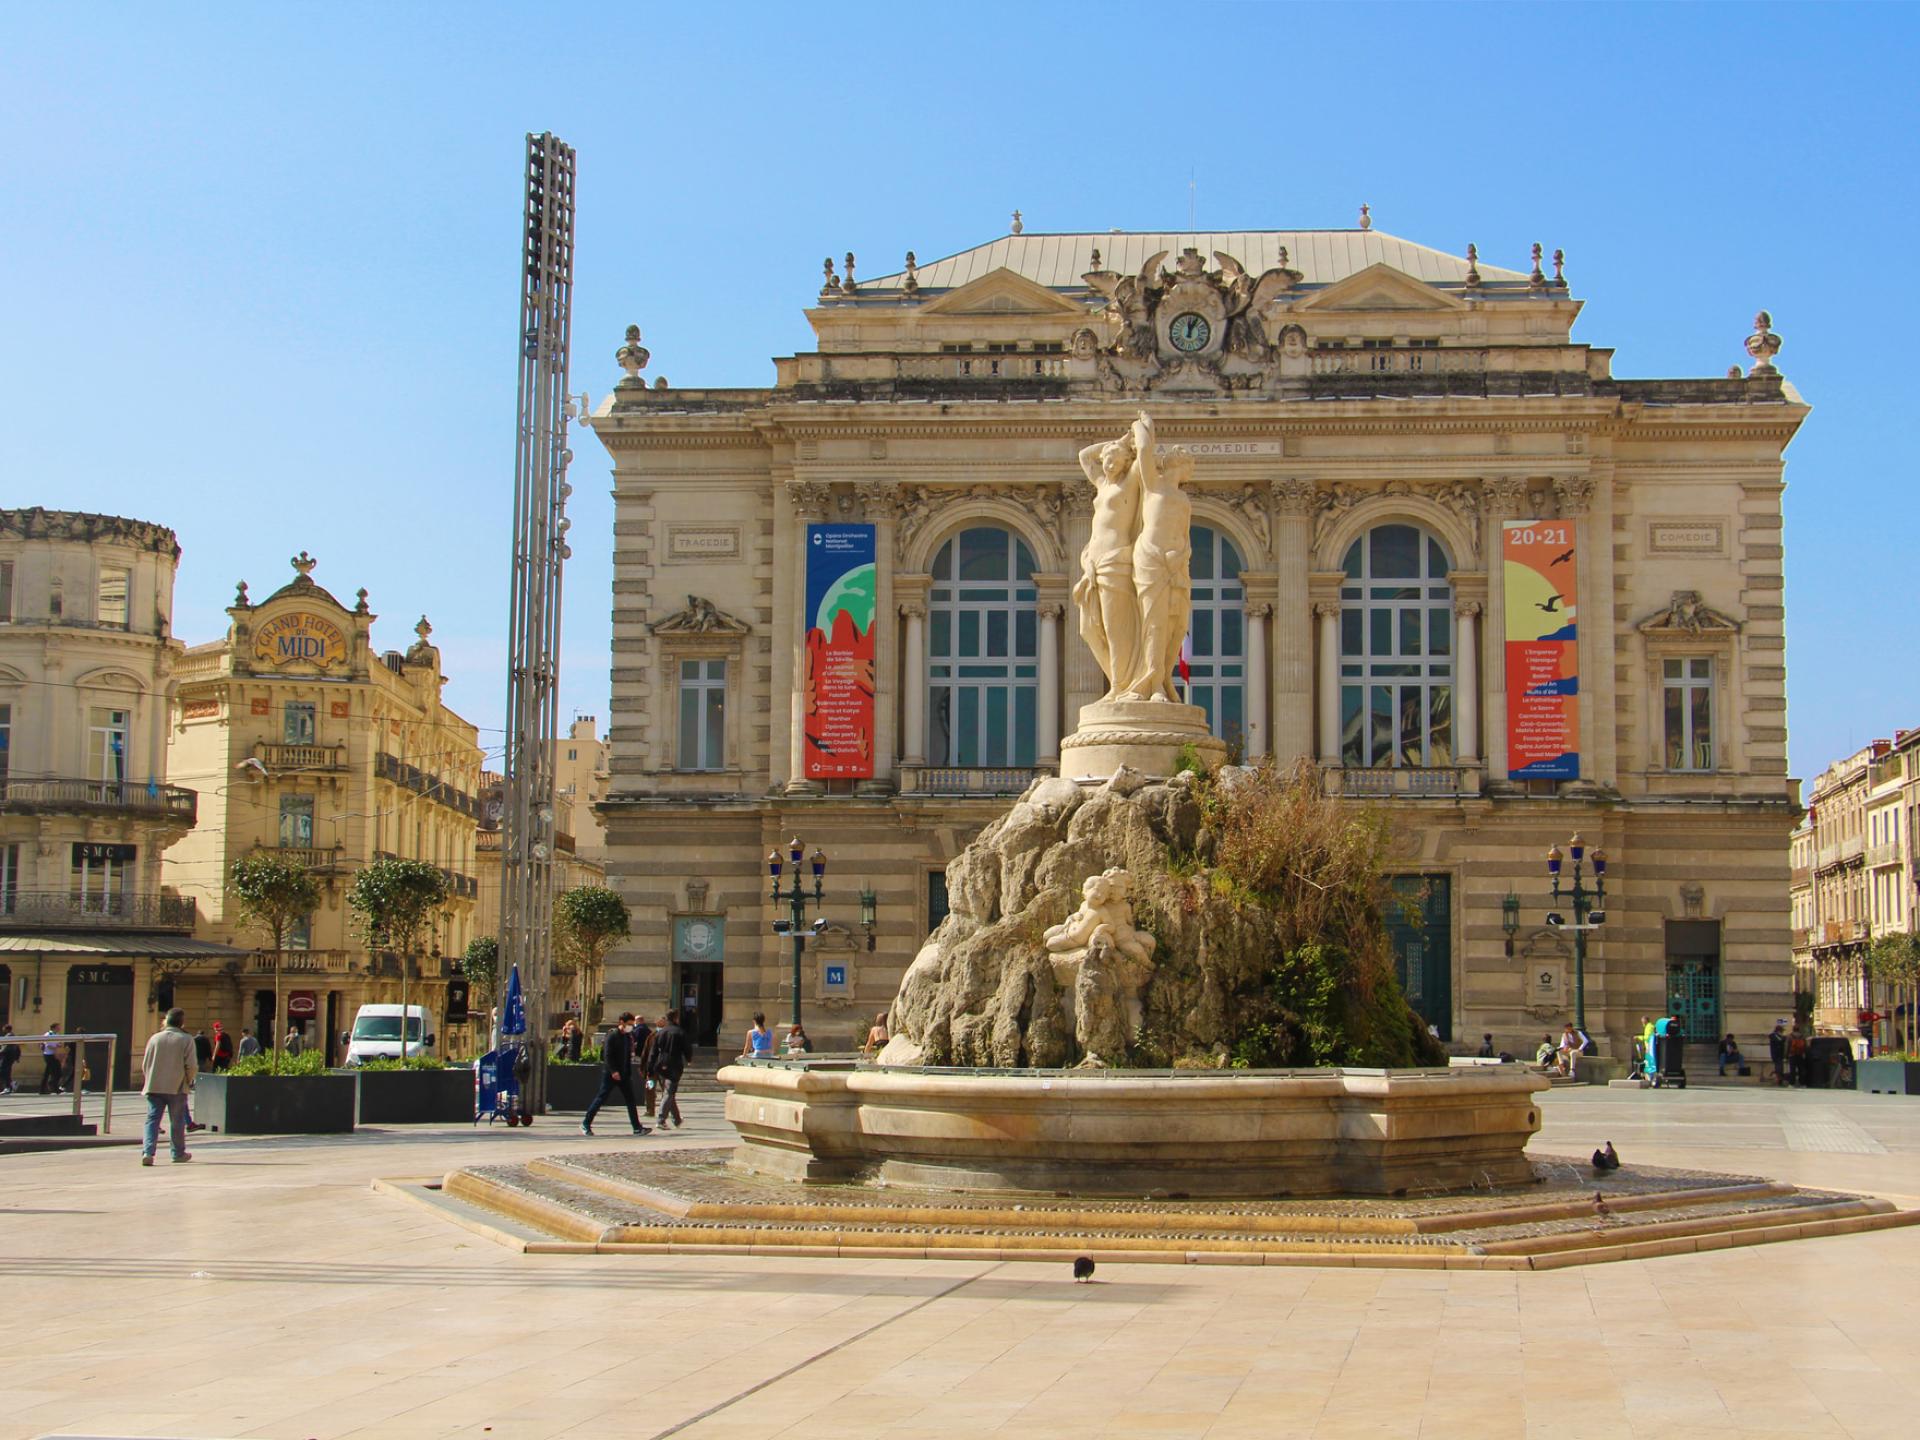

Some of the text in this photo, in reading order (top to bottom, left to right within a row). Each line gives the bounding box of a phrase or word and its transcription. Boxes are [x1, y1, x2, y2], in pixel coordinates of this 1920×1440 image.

[1190, 444, 1258, 453] COMEDIE
[260, 615, 342, 648] GRAND HOTEL
[277, 635, 325, 657] MIDI
[831, 972, 841, 982] M
